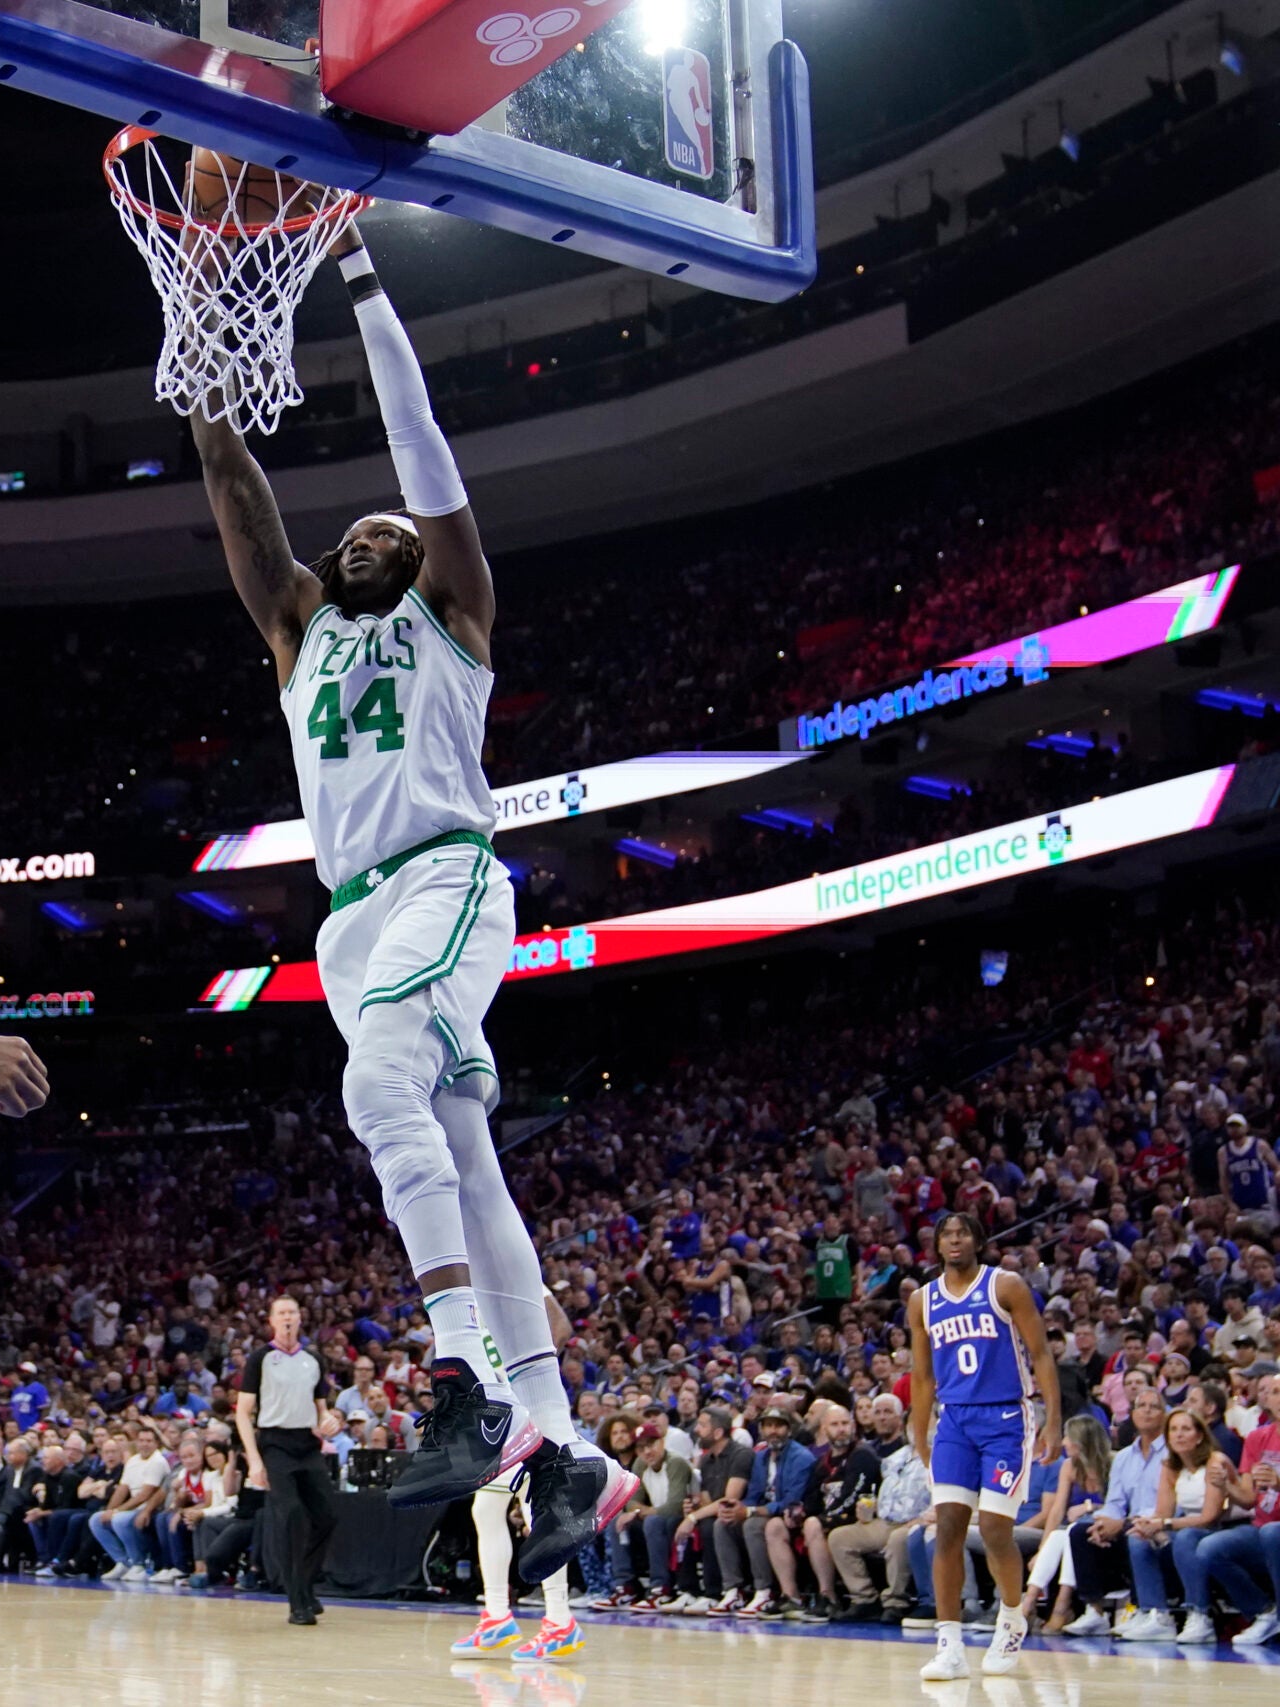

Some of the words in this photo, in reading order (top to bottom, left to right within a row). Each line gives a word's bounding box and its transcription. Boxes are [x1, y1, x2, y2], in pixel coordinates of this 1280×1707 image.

[673, 141, 696, 167] NBA
[307, 677, 405, 760] 44
[797, 655, 1008, 750] Independence
[816, 834, 1028, 910] Independence
[823, 1261, 835, 1277] 0
[930, 1313, 999, 1349] PHILA
[957, 1343, 978, 1375] 0
[991, 1469, 1014, 1488] 76
